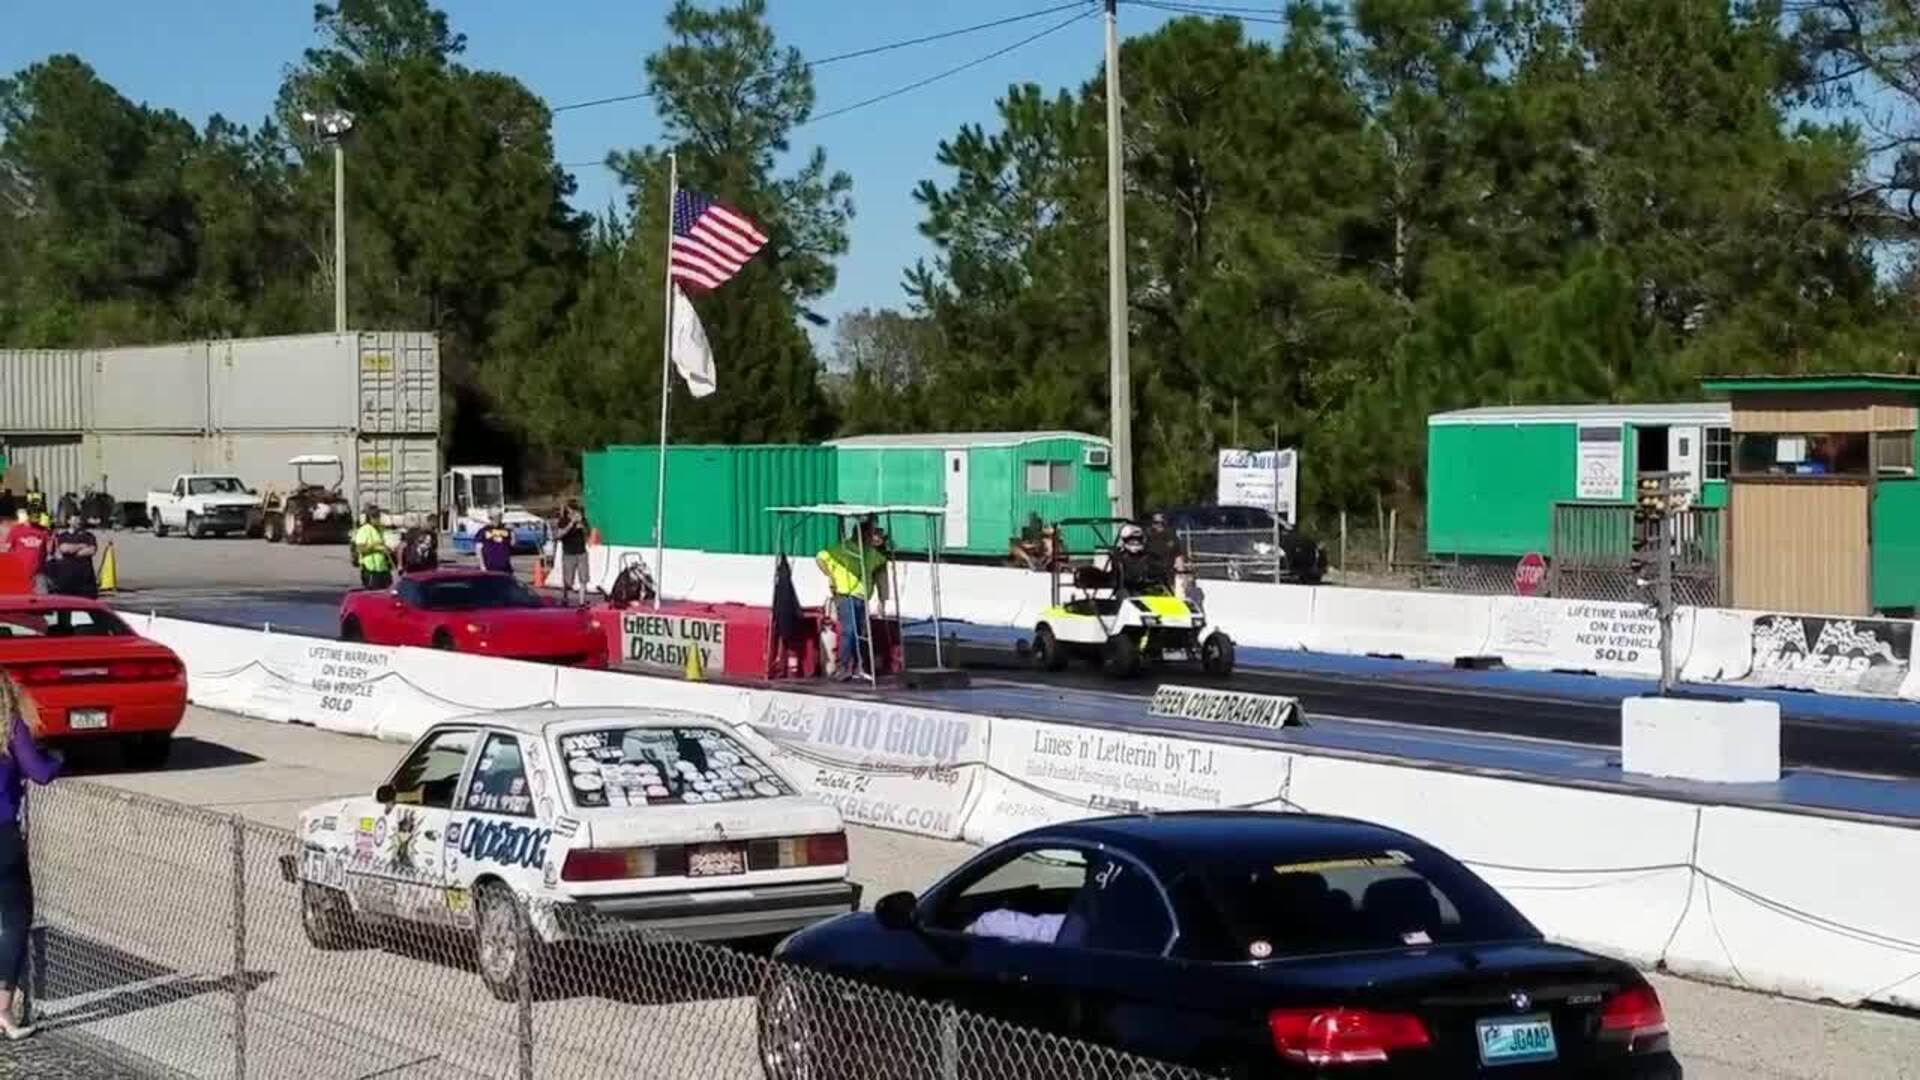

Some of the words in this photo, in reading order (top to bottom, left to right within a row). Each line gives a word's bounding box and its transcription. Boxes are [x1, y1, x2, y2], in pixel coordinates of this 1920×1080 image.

[1516, 565, 1544, 584] STOP
[1567, 604, 1616, 618] LIFETIME
[624, 616, 673, 637] GREEN
[1590, 620, 1608, 632] ON
[1612, 621, 1656, 634] EVERY
[1576, 633, 1606, 645] NEW
[631, 636, 711, 669] DRAGWY
[1595, 648, 1639, 662] SOLD
[321, 663, 336, 676] ON
[337, 665, 368, 679] EVERY
[312, 677, 332, 692] NEW
[333, 681, 375, 698] VEHICLE
[320, 695, 354, 712] SOLD
[1151, 688, 1186, 714] GREEN
[1214, 693, 1290, 727] DRAGWAY
[817, 706, 882, 750] AUTO
[884, 712, 969, 761] GROUP
[1034, 729, 1073, 757] Lines
[1096, 737, 1162, 770] Letterin'
[1164, 743, 1185, 777] by
[1187, 748, 1218, 776] T.J.
